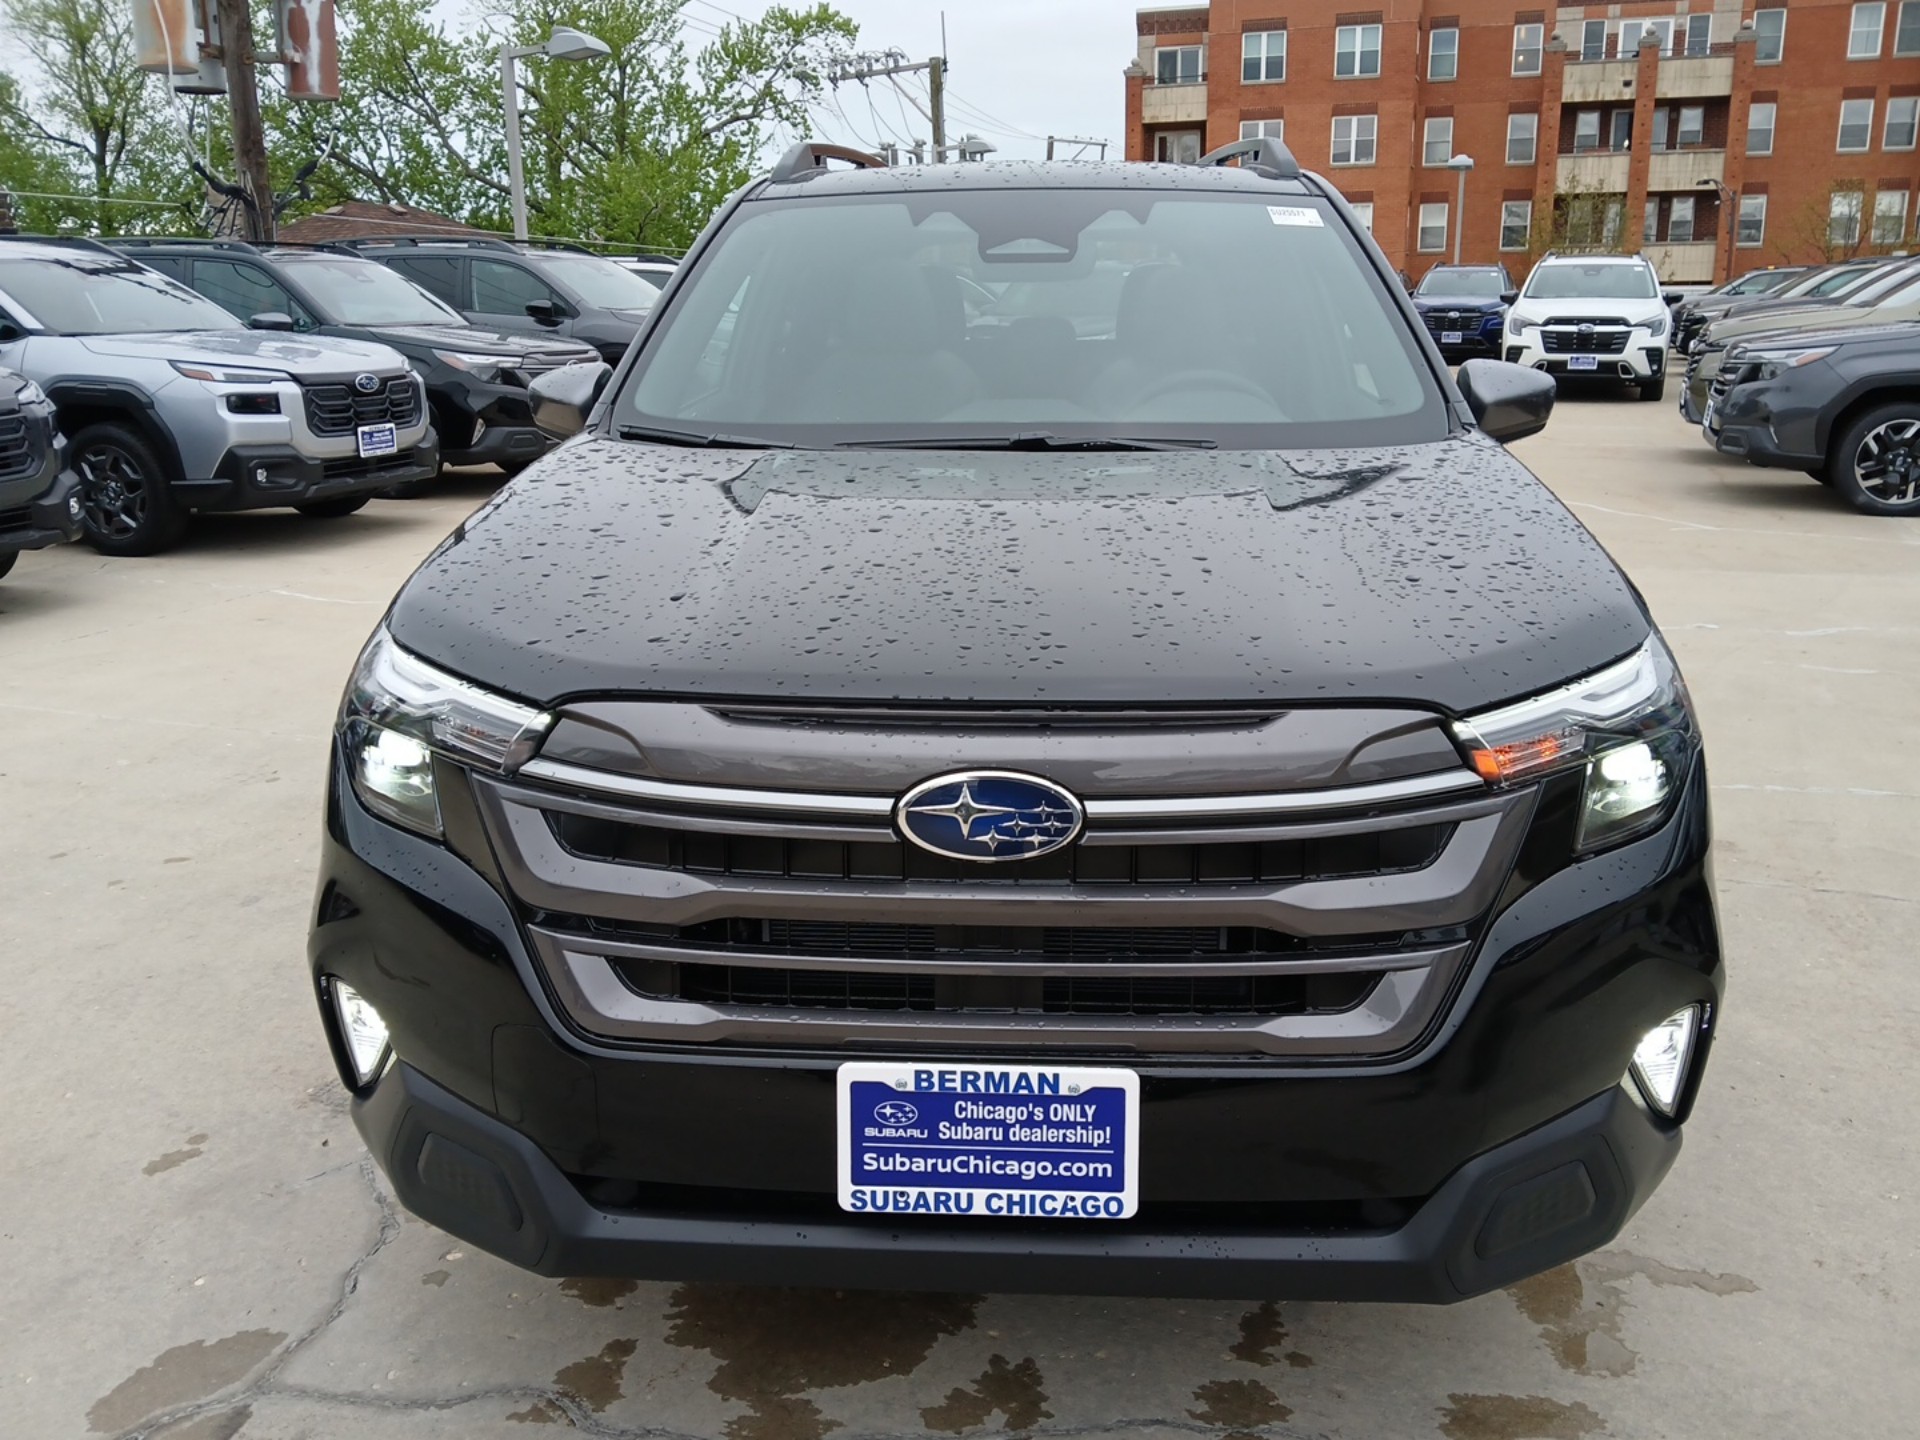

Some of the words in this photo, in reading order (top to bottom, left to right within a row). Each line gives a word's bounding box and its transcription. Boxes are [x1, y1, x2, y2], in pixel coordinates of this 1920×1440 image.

[914, 1069, 1060, 1095] BERMAN
[954, 1100, 1044, 1124] Chicago's
[1049, 1103, 1097, 1123] ONLY
[864, 1127, 928, 1139] SUBARU
[938, 1121, 1003, 1141] Subaru
[1009, 1123, 1111, 1147] dealership!
[862, 1152, 1113, 1180] SubaruChicago.com
[850, 1189, 975, 1214] SUBARU
[984, 1192, 1125, 1218] CHICAGO
